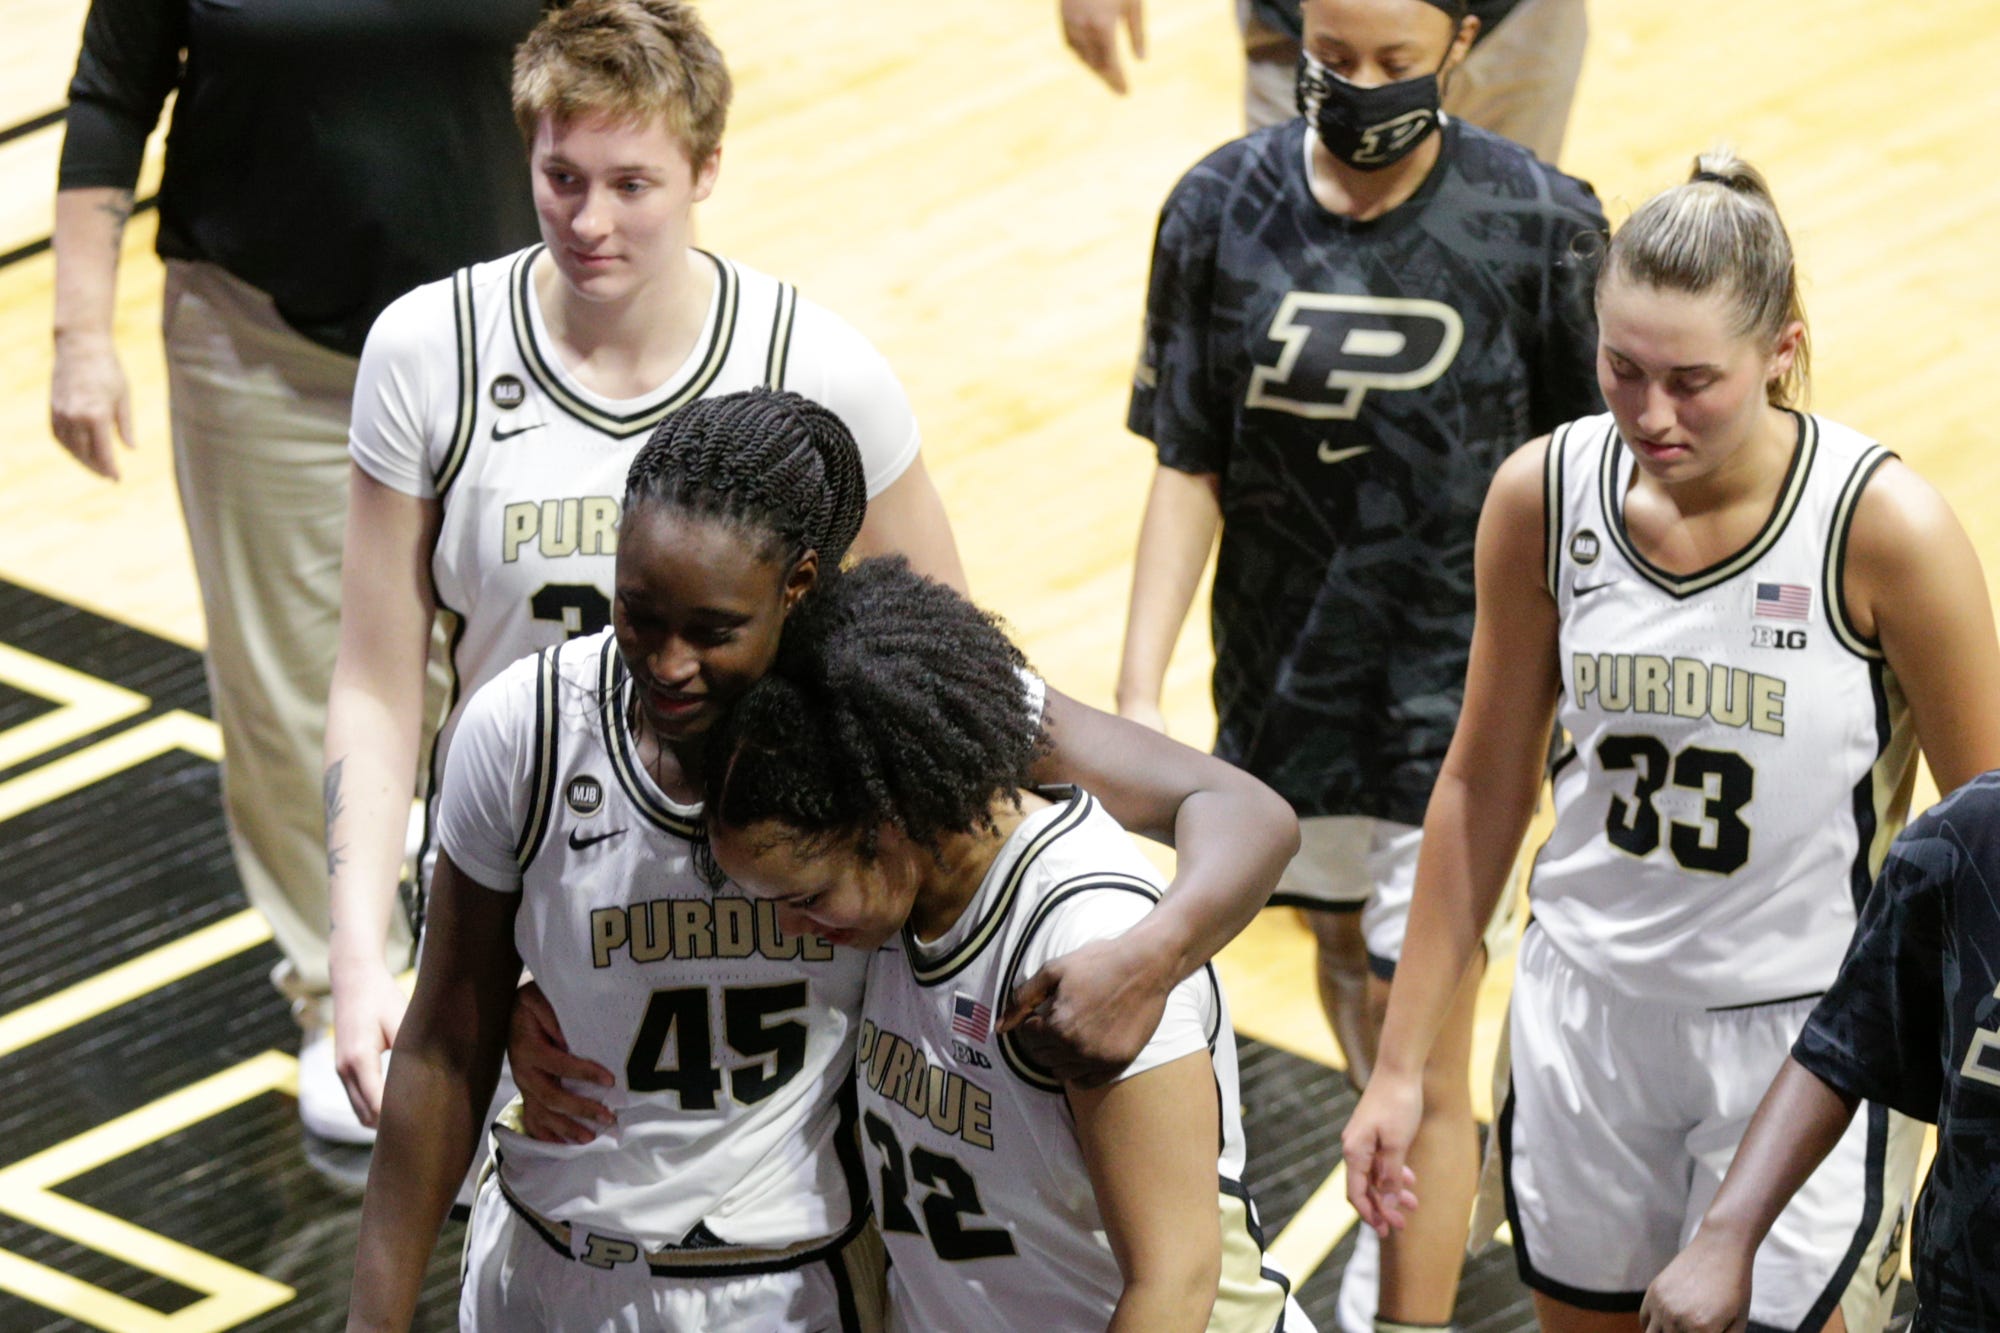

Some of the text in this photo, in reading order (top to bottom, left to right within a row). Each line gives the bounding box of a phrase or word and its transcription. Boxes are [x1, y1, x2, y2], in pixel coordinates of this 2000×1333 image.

[1245, 290, 1464, 420] P
[503, 496, 620, 563] PUR
[1573, 653, 1786, 737] PURDUE
[572, 784, 598, 803] MJB
[1596, 734, 1755, 878] 33
[626, 978, 810, 1112] 45
[857, 1018, 994, 1151] PURDUE
[863, 1107, 1020, 1262] 22
[580, 1232, 638, 1270] P
